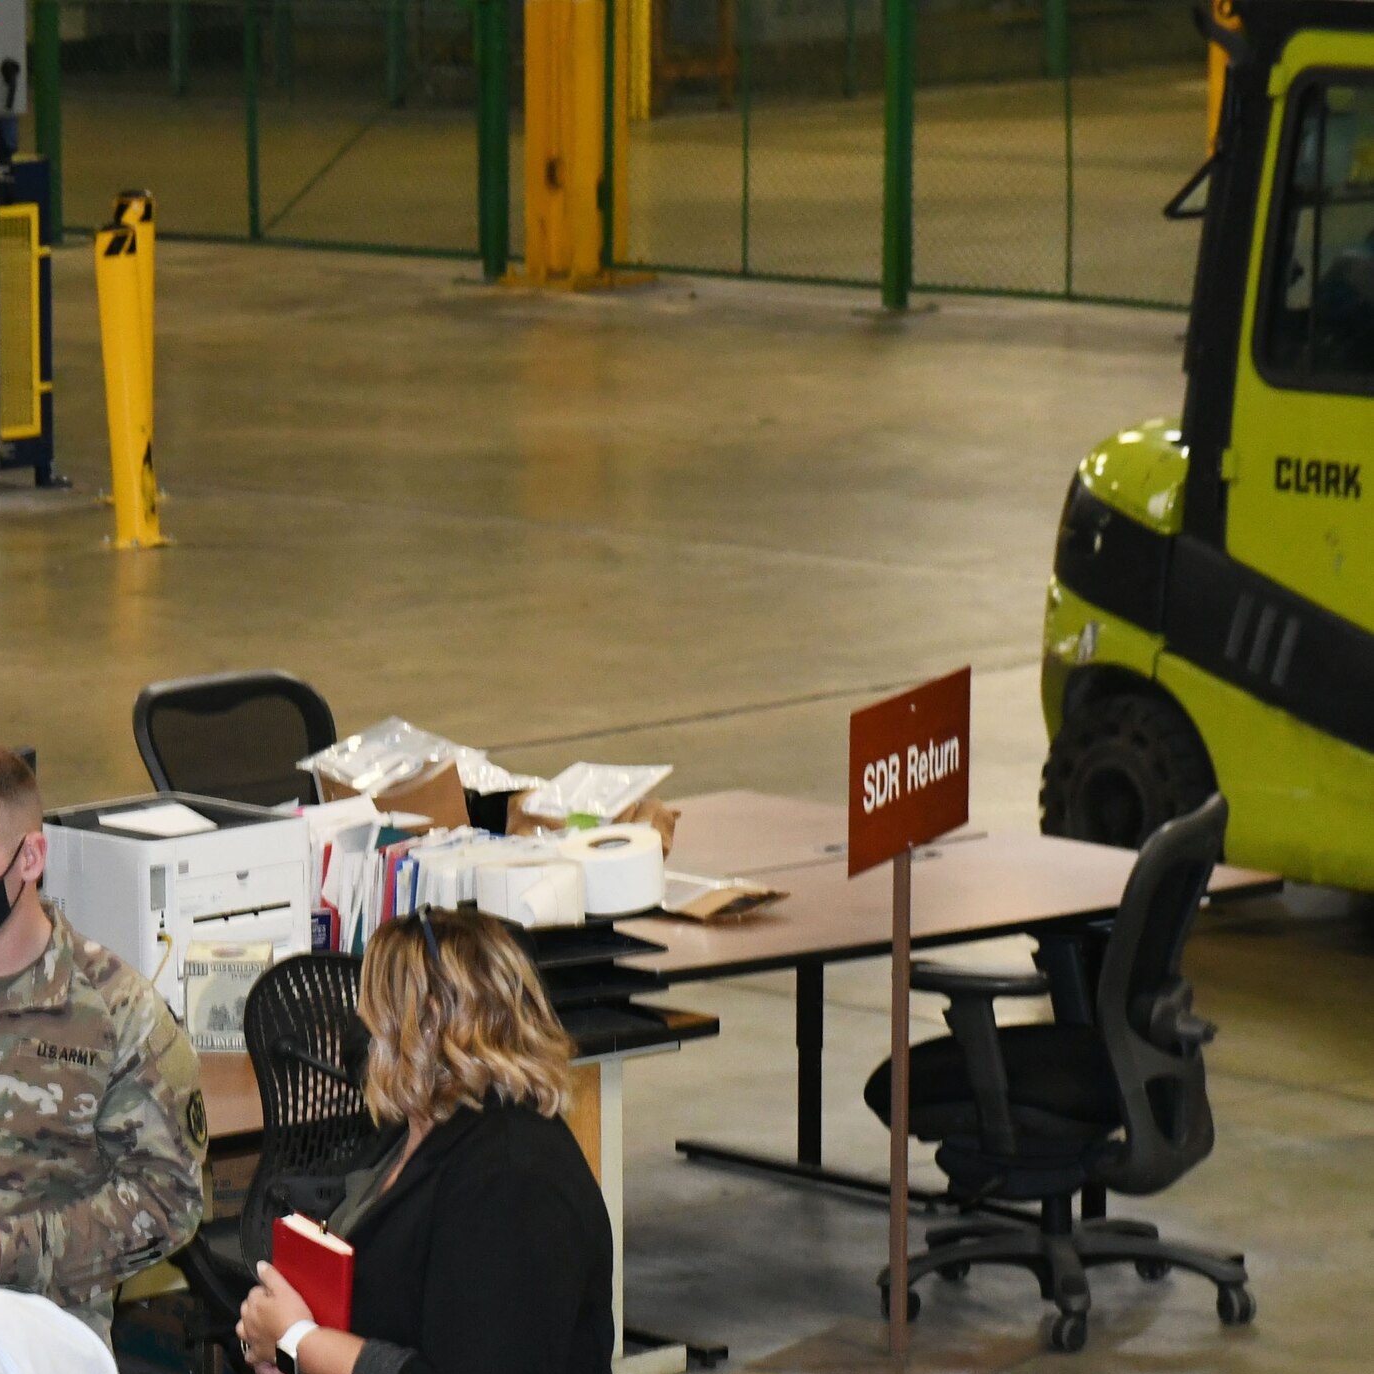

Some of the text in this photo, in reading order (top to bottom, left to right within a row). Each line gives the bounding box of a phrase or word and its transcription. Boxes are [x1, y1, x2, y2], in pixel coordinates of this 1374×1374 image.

[1274, 457, 1362, 500] CLARK
[863, 735, 960, 815] SDR Return
